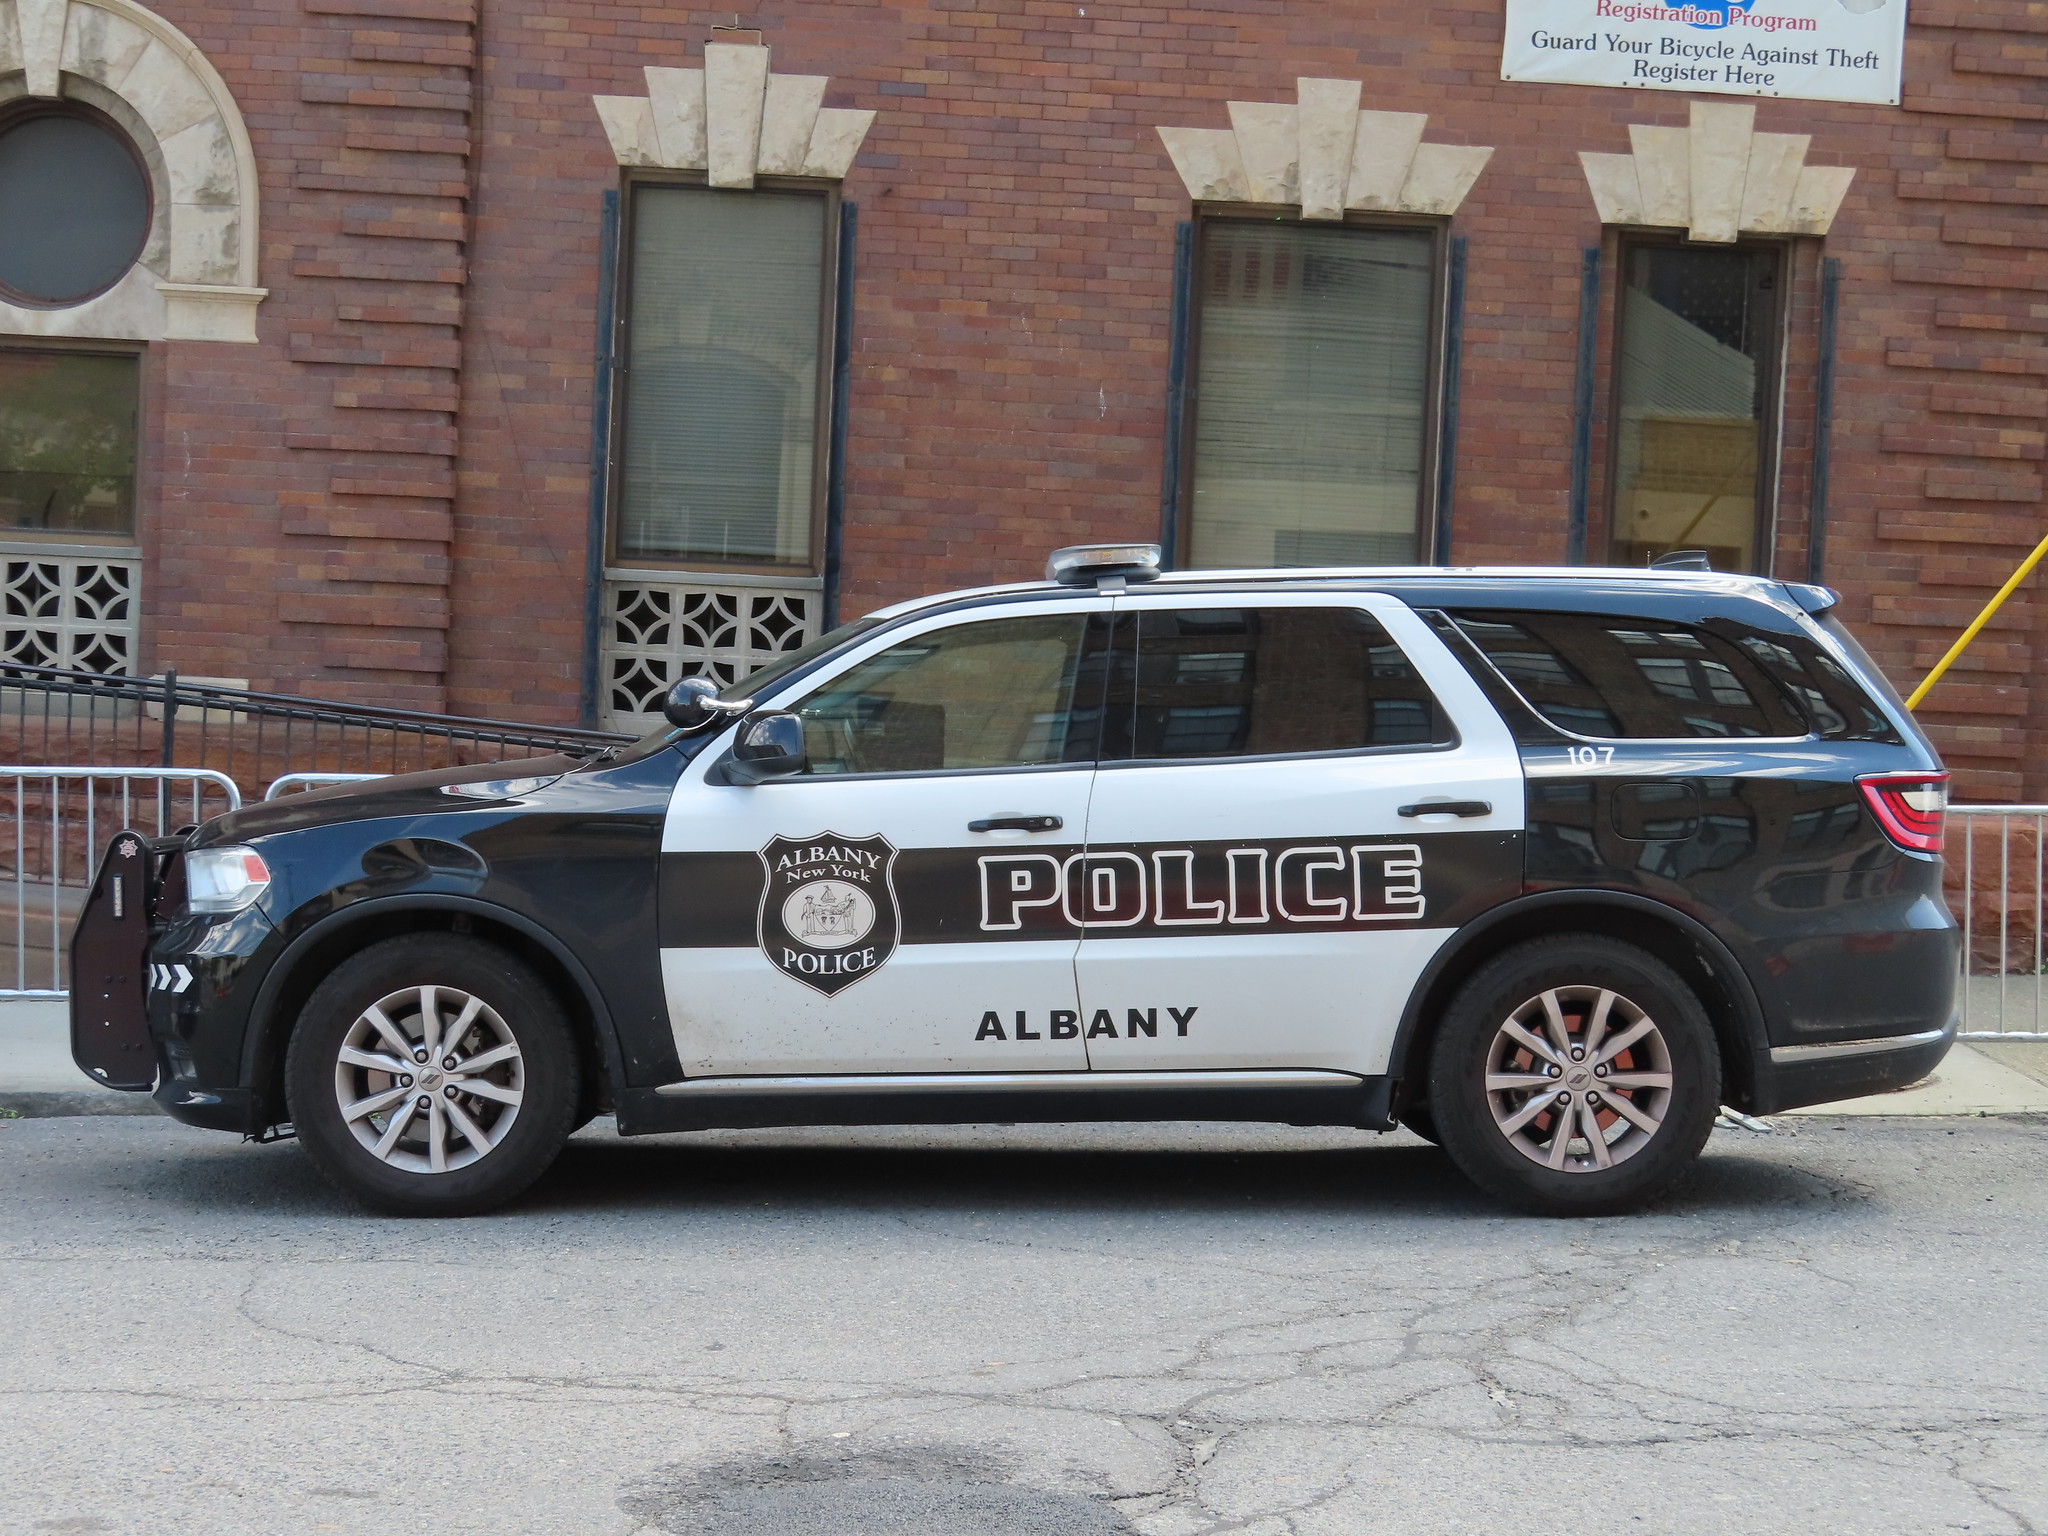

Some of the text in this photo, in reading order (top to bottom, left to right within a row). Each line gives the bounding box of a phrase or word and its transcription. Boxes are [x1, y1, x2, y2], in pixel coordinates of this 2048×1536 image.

[1596, 0, 1817, 32] Registration Program
[1531, 30, 1880, 70] Guard Your Bicycle Against Theft
[1633, 59, 1776, 86] Register Here
[1567, 746, 1615, 765] 107
[775, 846, 882, 873] ALBANY
[786, 864, 871, 884] New York
[977, 843, 1426, 931] POLICE
[783, 947, 876, 975] POLICE
[975, 1006, 1199, 1041] ALBANY
